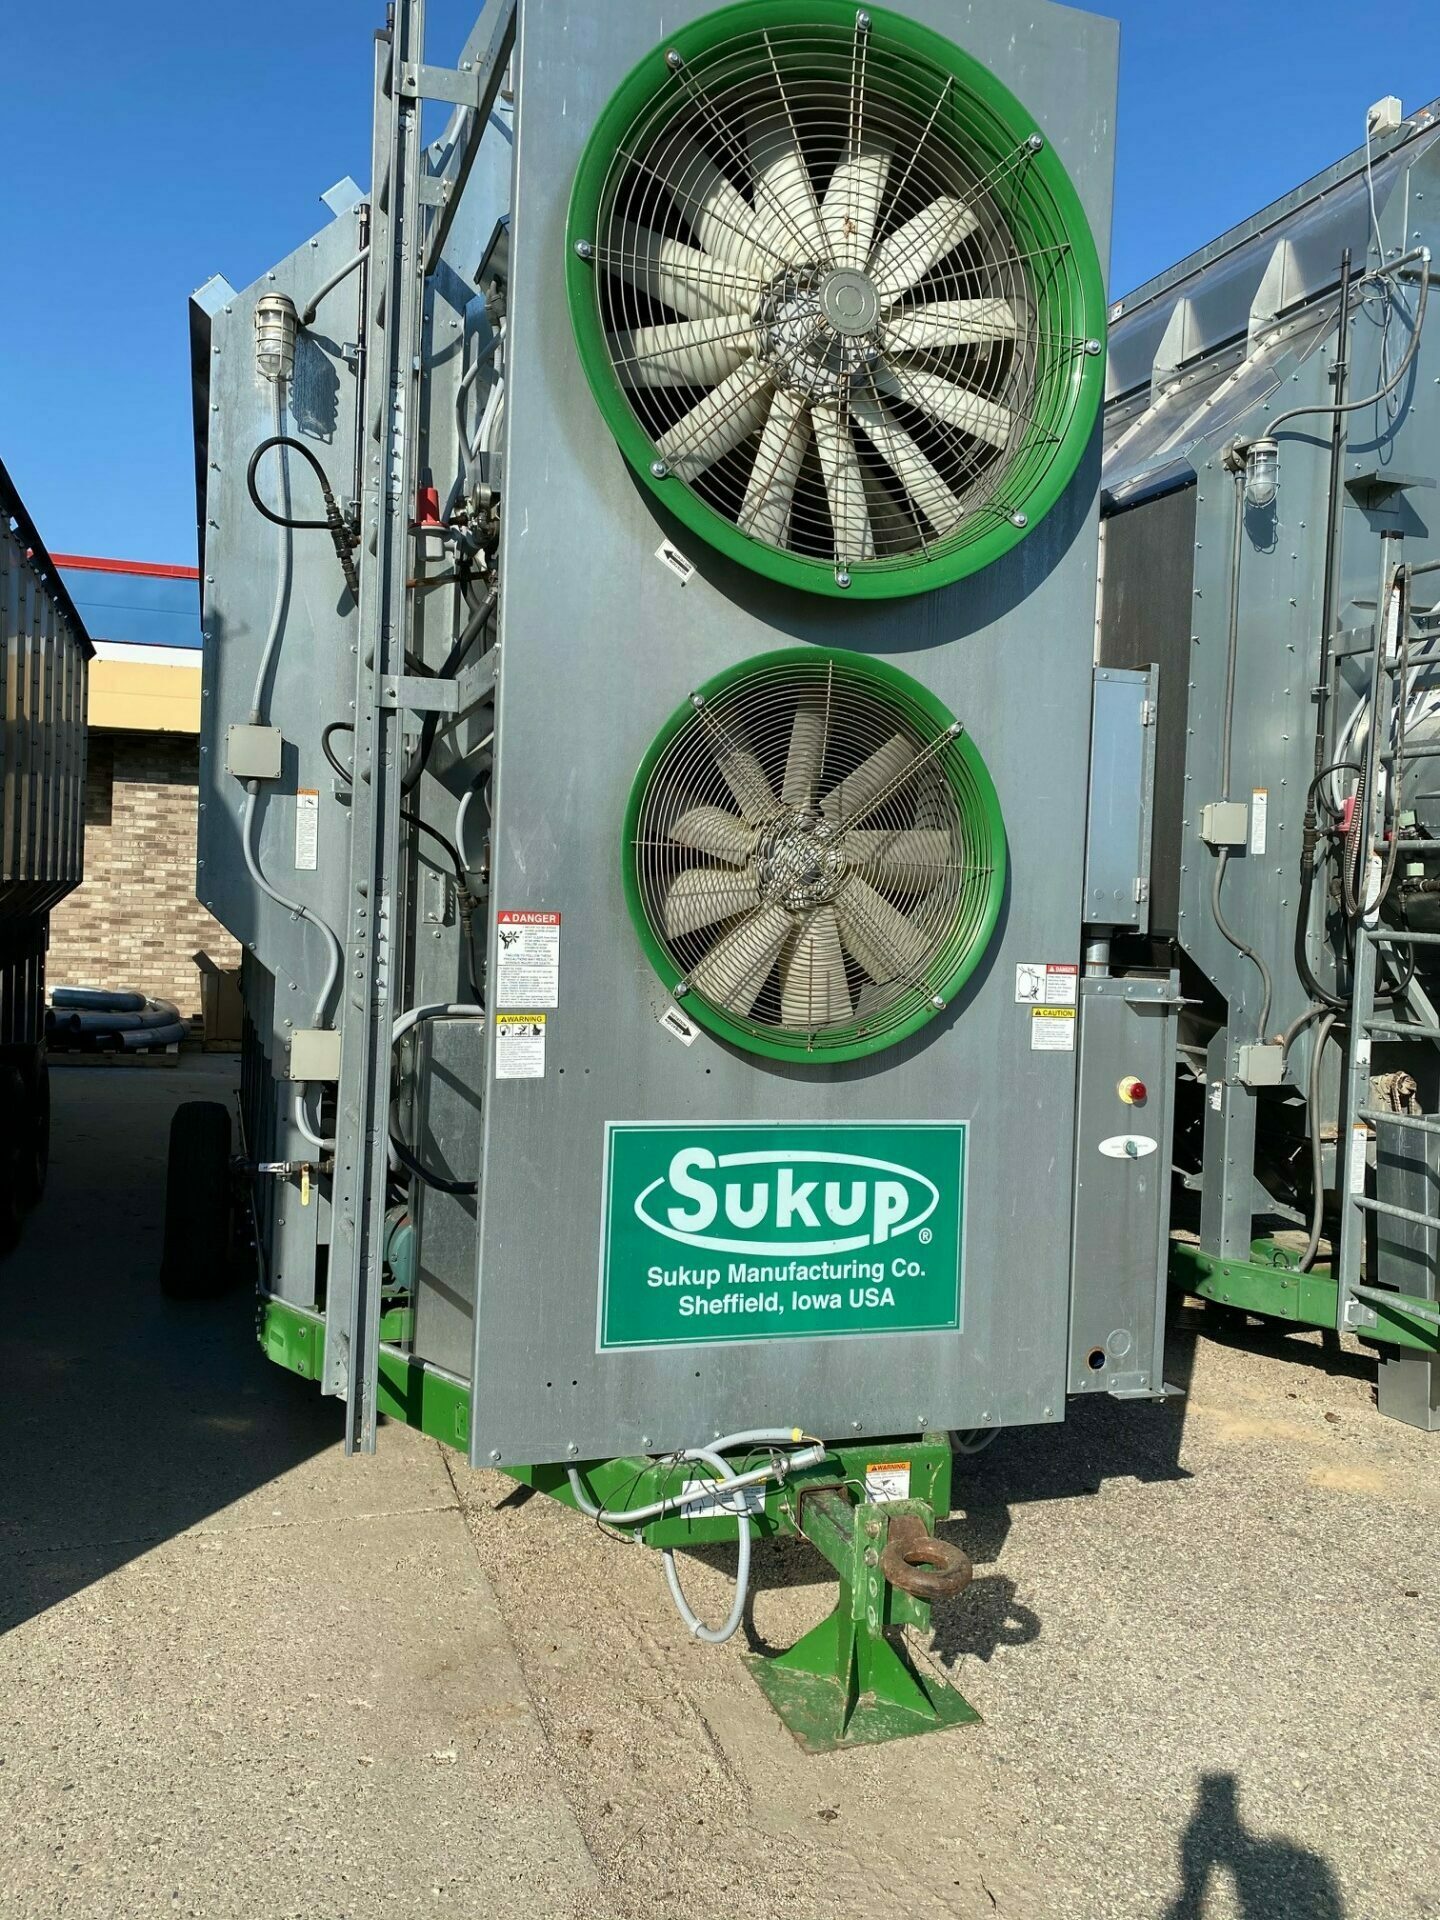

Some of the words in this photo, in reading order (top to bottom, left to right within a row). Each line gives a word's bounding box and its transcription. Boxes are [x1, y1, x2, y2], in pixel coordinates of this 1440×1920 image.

[512, 913, 556, 923] DANGER
[1042, 1009, 1073, 1017] CAUTION
[667, 1147, 909, 1245] Sukup
[647, 1266, 721, 1289] Sukup
[727, 1259, 884, 1283] Manufacturing
[891, 1258, 926, 1278] Co.
[678, 1293, 784, 1316] Sheffield,
[792, 1291, 842, 1310] Iowa
[849, 1288, 895, 1308] USA
[877, 1463, 906, 1471] WARNING
